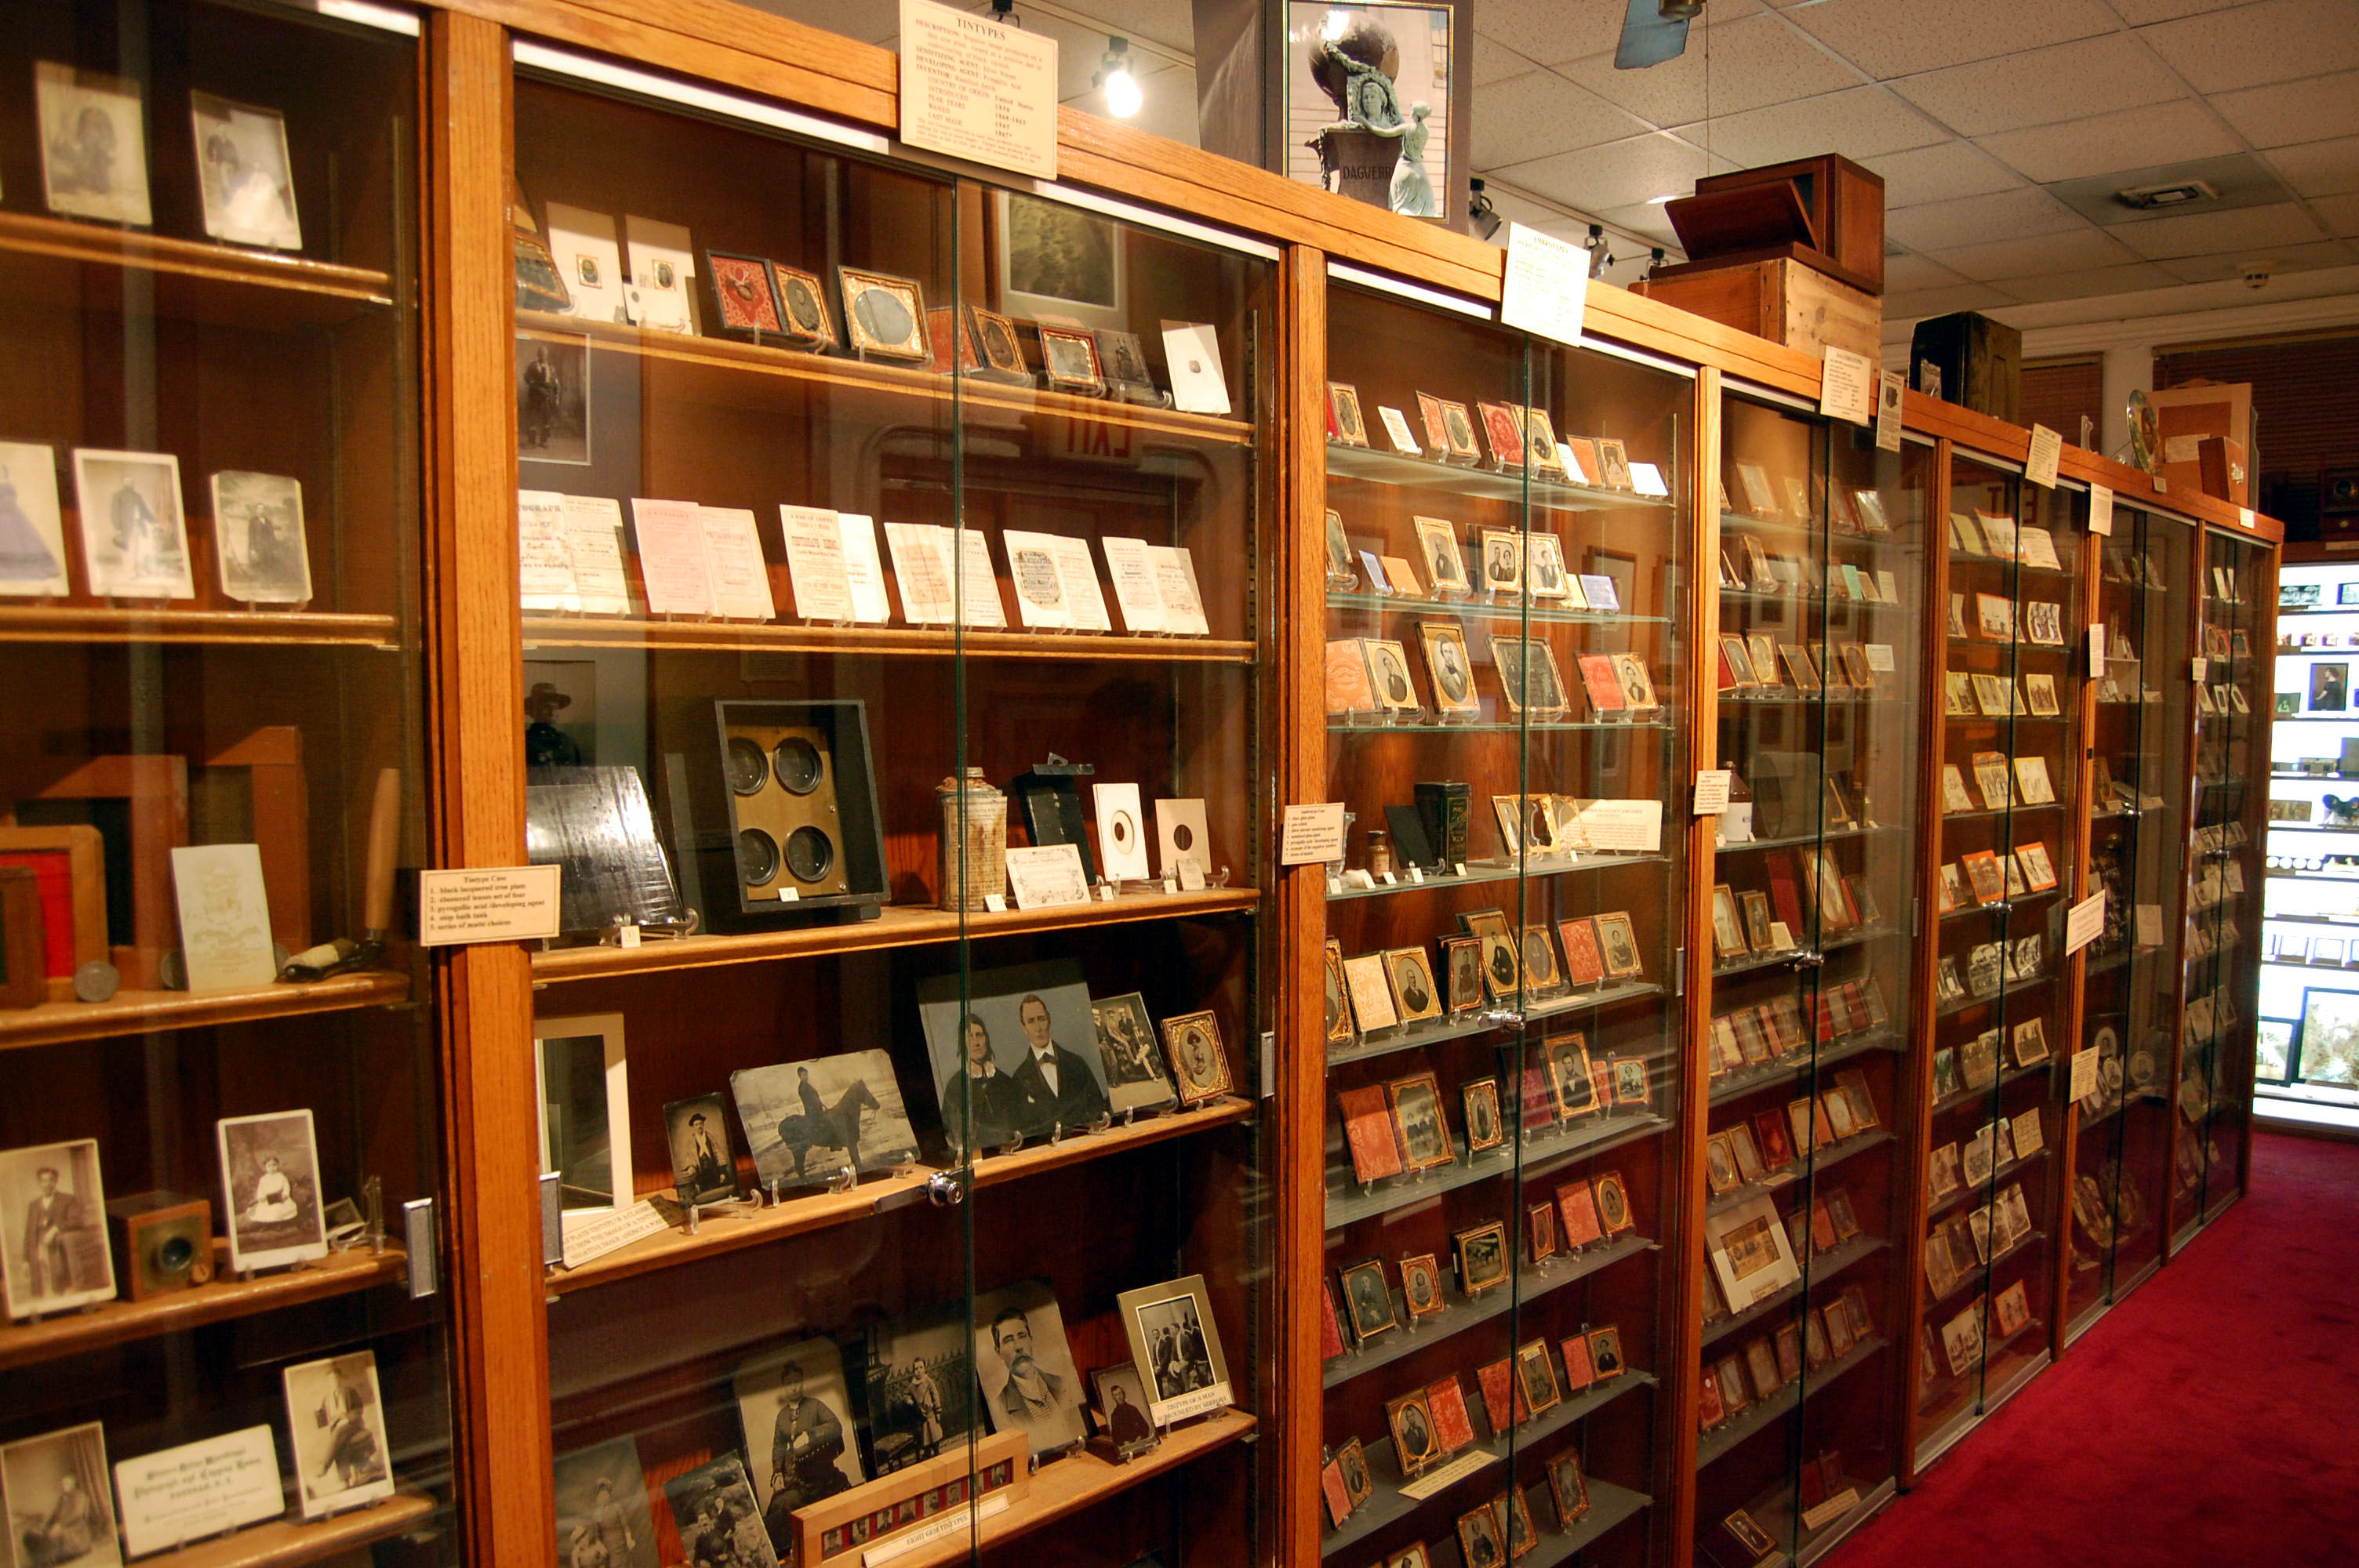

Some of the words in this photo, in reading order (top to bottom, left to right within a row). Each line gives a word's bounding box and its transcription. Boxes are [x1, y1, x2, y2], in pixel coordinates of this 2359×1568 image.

[957, 18, 1005, 39] TINTYPES
[464, 875, 489, 884] Tintype
[460, 884, 493, 893] lacquered
[907, 1534, 925, 1545] EIGHT
[925, 1527, 940, 1537] GEM
[940, 1515, 968, 1530] TINTYPES
